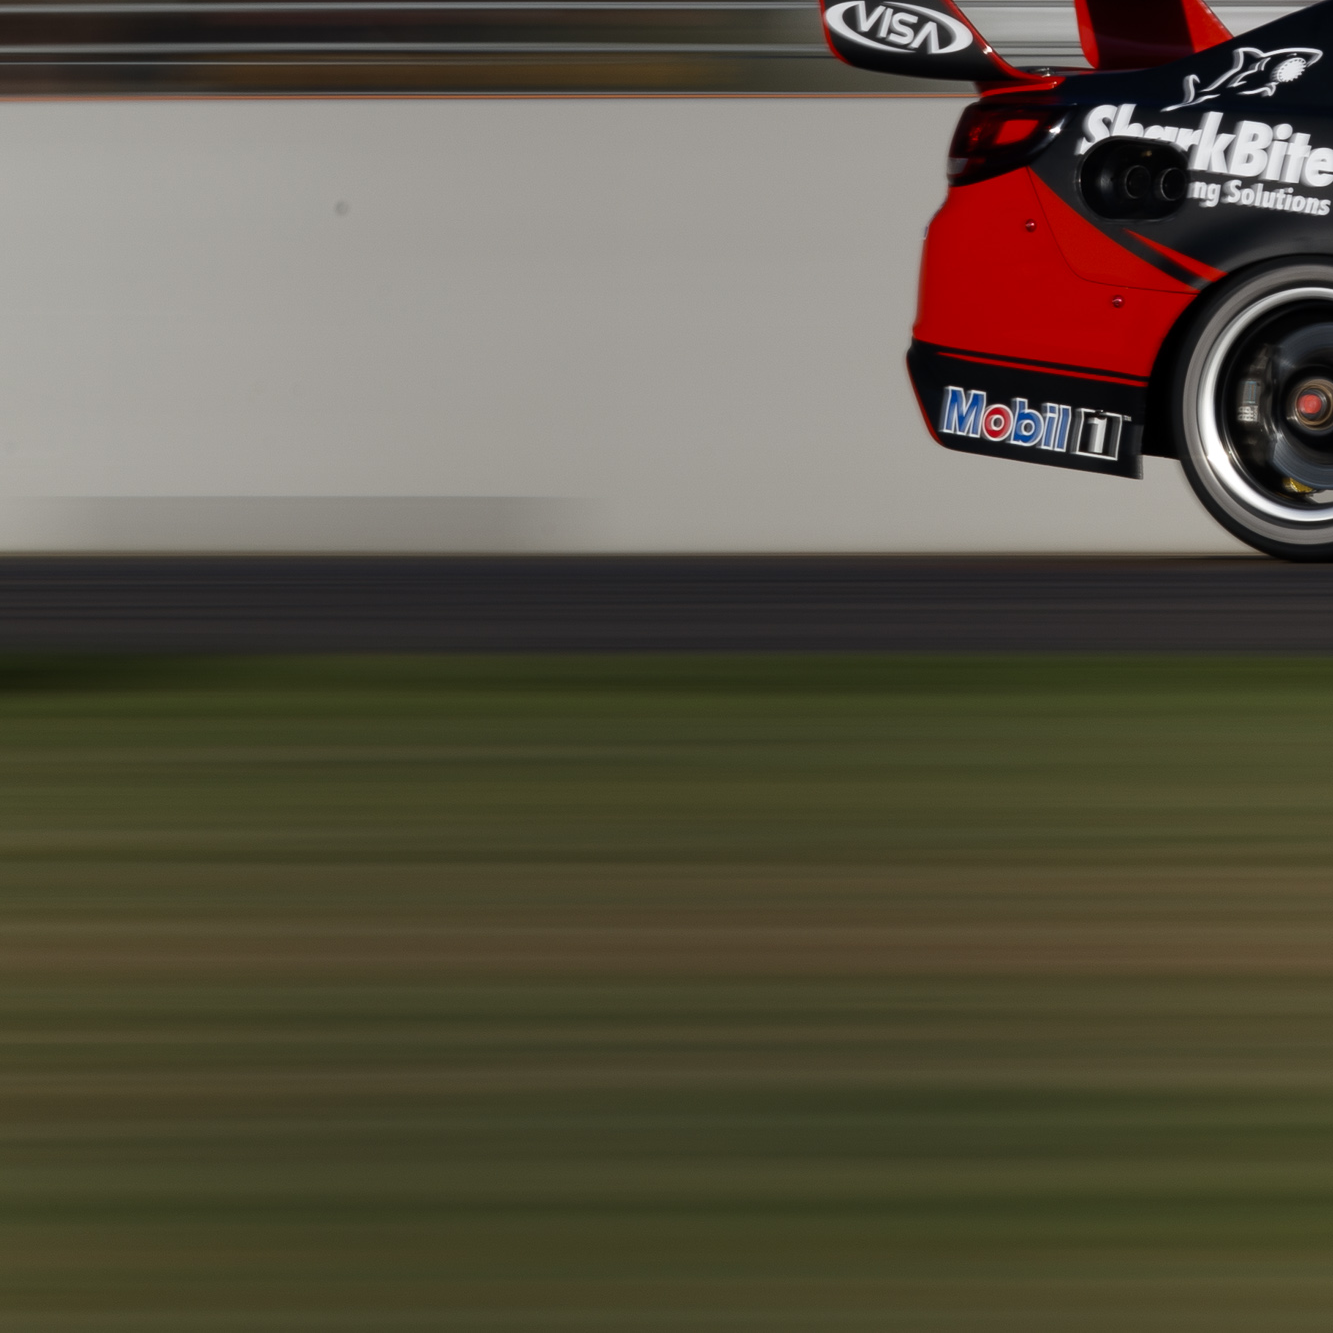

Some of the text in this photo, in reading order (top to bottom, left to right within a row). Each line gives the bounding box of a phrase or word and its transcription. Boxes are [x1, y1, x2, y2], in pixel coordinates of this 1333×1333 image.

[855, 0, 941, 54] VISA
[1222, 179, 1331, 216] Solutions
[939, 386, 1072, 452] Mobil
